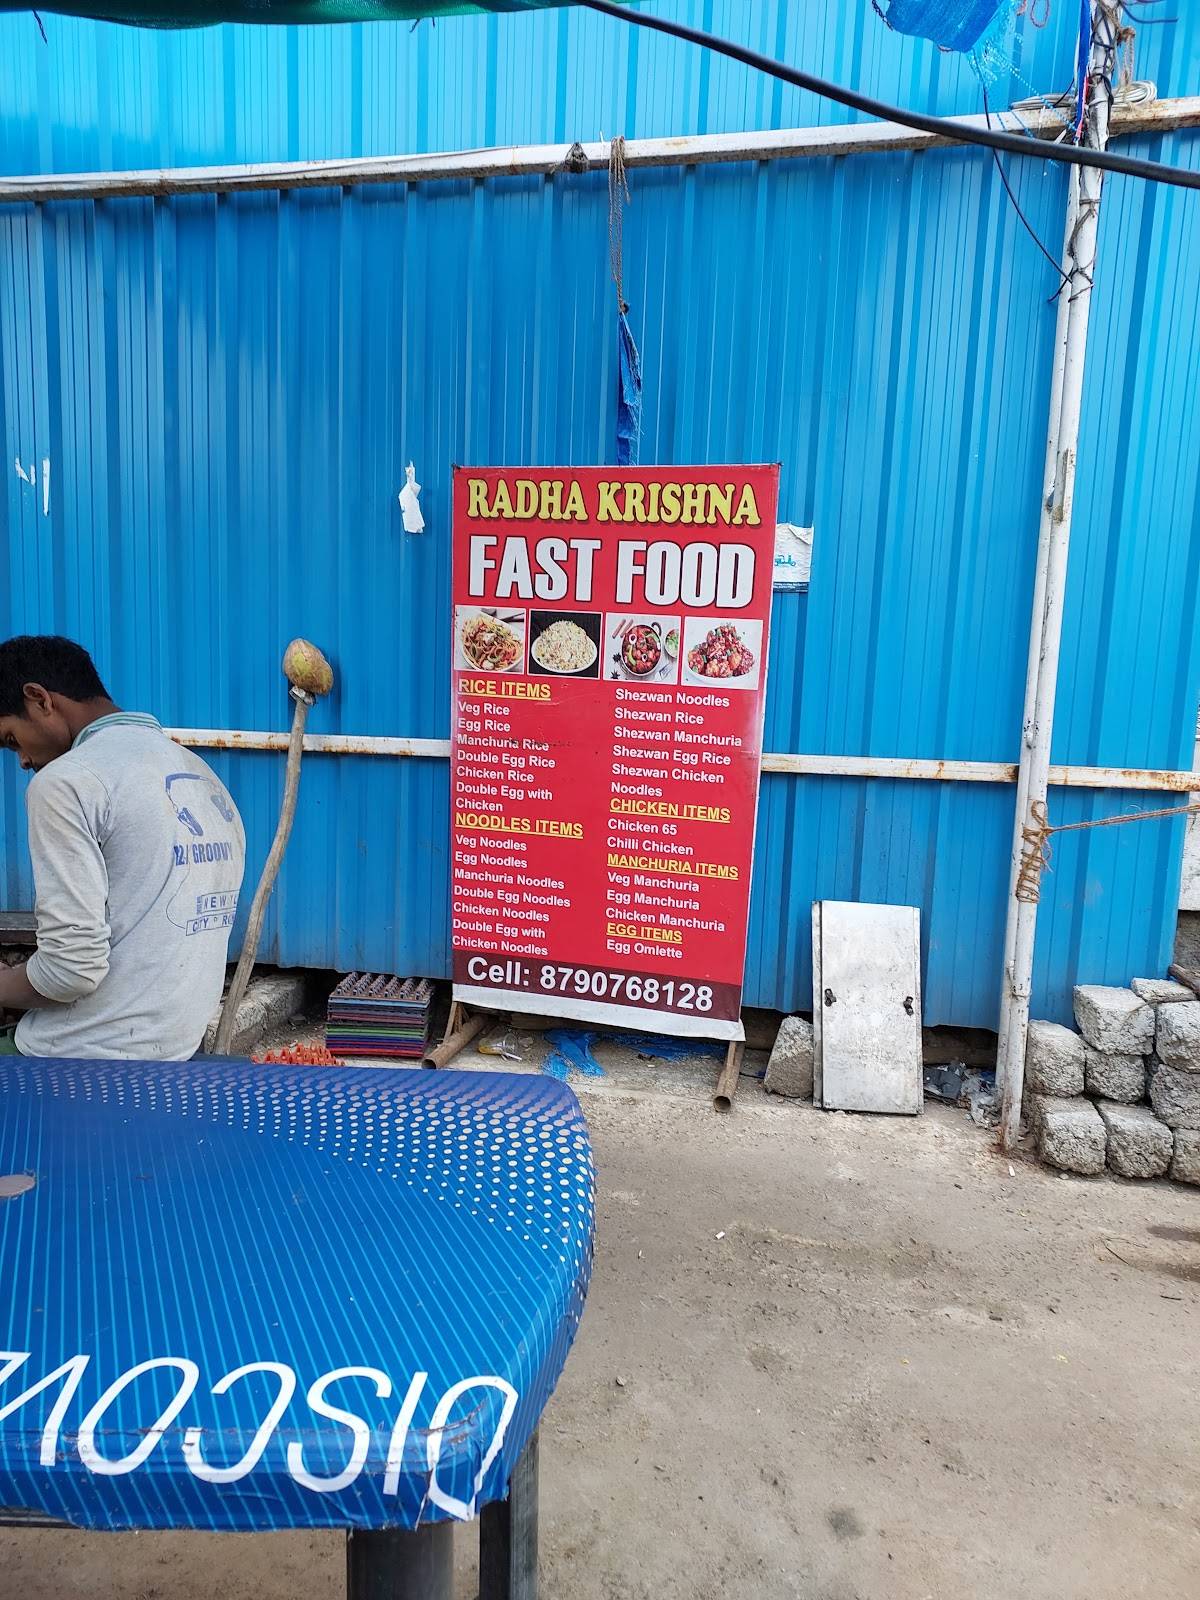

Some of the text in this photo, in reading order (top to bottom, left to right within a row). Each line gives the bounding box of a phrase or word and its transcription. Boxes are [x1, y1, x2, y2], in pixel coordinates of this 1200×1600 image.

[468, 479, 761, 526] RADHA KRISHNA
[469, 535, 756, 608] FAST FOOD
[458, 679, 551, 698] RICE ITEMS
[616, 689, 730, 707] Shezwan Noodles
[458, 701, 510, 715] Veg Rice
[615, 708, 704, 724] Shezwan Rice
[458, 718, 510, 732] Egg Rice
[457, 734, 549, 751] Manchuria Rice
[614, 726, 742, 746] Shezwan Manchuria
[457, 750, 555, 768] Double Egg Rice
[613, 745, 731, 765] Shezwan Egg Rice
[457, 766, 534, 782] Chicken Rice
[612, 764, 724, 783] Shezwan Chicken
[456, 782, 552, 800] Double Egg with
[611, 782, 662, 796] Noodles
[456, 798, 503, 811] Chicken
[610, 798, 730, 820] CHICKEN ITEMS
[456, 813, 583, 836] NOODLES ITEMS
[608, 819, 677, 835] Chicken 65
[456, 835, 527, 851] Veg Noodles
[607, 837, 694, 855] Chilli Chicken
[192, 842, 233, 864] GROOVY
[455, 851, 527, 868] Egg Noodles
[607, 854, 738, 877] MANCHURIA ITEMS
[455, 868, 564, 889] Manchuria Noodles
[608, 872, 699, 892] Veg Manchuria
[454, 886, 570, 907] Double Egg Noodles
[607, 890, 699, 910] Egg Manchuria
[454, 902, 549, 921] Chicken Noodles
[606, 908, 724, 931] Chicken Manchuria
[453, 919, 545, 938] Double Egg with
[607, 923, 682, 941] EGG ITEMS
[452, 936, 548, 955] Chicken Noodles
[607, 939, 683, 958] Egg Omlette
[468, 957, 712, 1011] Cell: 8790768128
[0, 1351, 519, 1521] DISCOV
